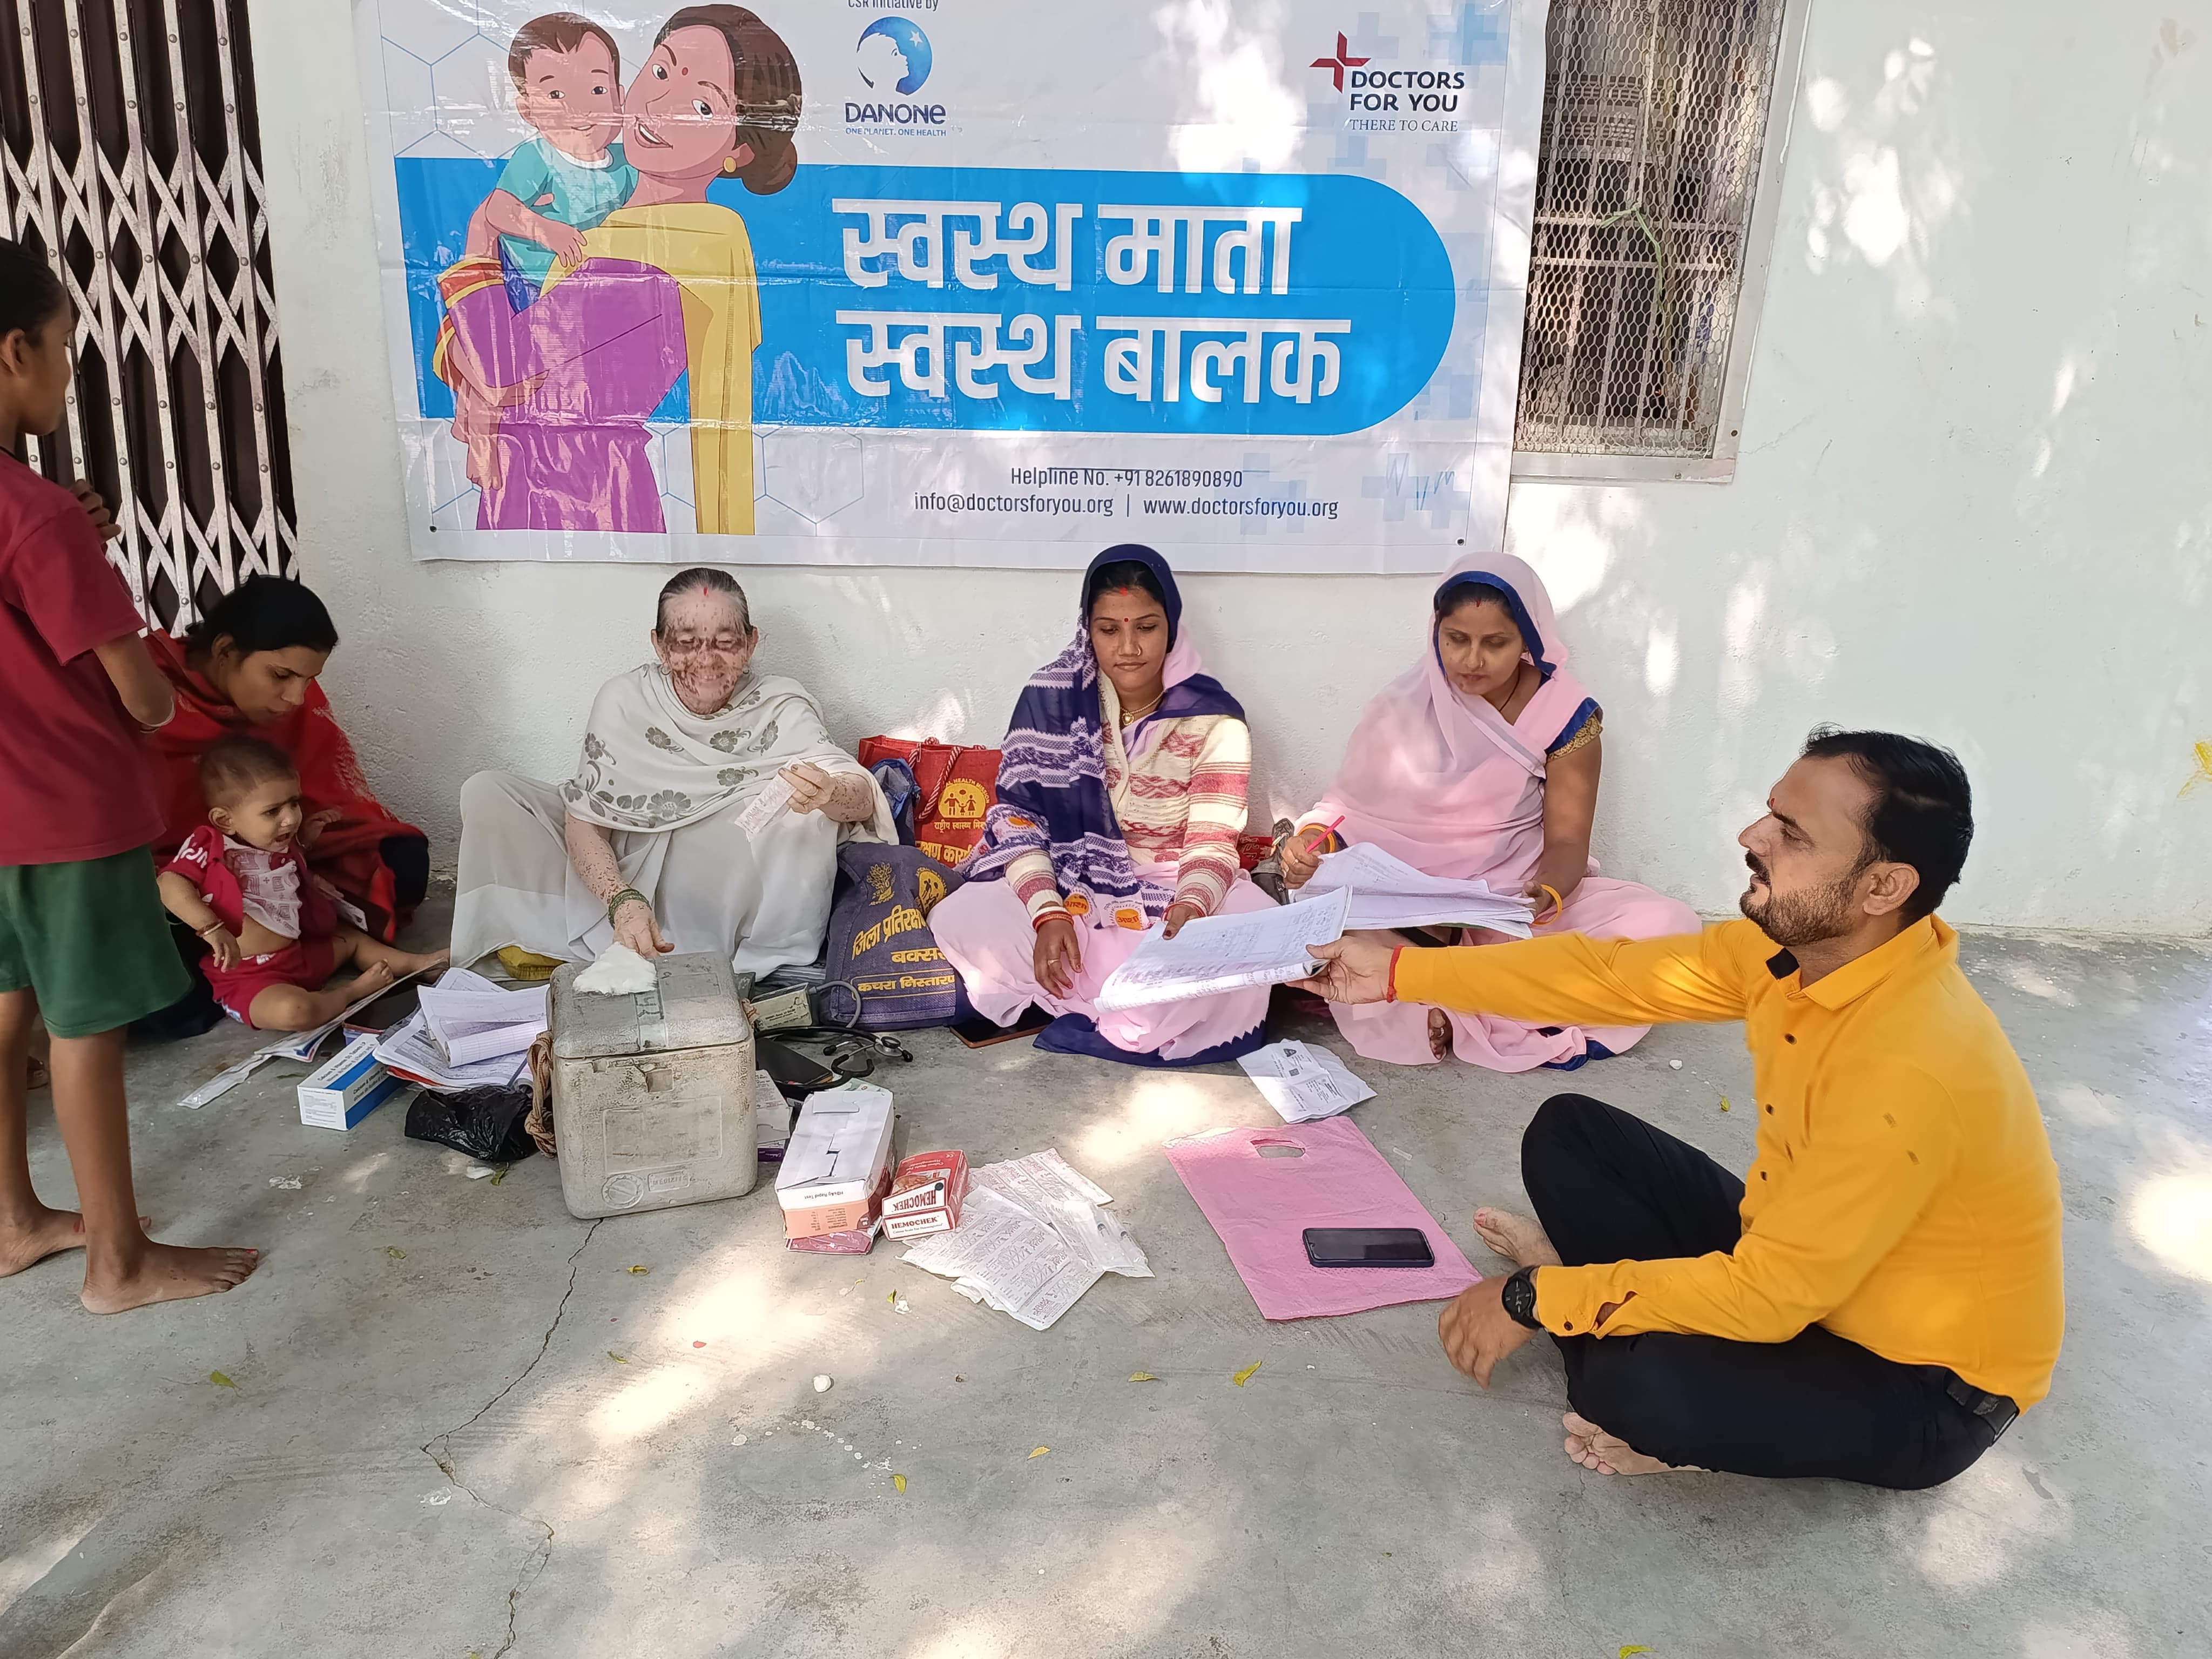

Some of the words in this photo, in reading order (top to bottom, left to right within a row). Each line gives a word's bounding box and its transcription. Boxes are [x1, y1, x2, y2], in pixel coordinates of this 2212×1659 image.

[1351, 70, 1465, 89] DOCTORS
[1350, 93, 1399, 111] FOR
[1408, 94, 1458, 112] YOU
[845, 127, 862, 135] ONE
[1348, 119, 1396, 131] THERE
[1399, 119, 1418, 131] TO
[1421, 120, 1458, 132] CARE
[832, 198, 1083, 292] स्वस्थ
[1098, 203, 1302, 295] माता
[835, 309, 1082, 400] स्वस्थ
[1096, 315, 1352, 404] बालक
[1011, 467, 1079, 488] Helpline
[1084, 468, 1109, 485] No.
[914, 491, 1114, 517] info@doctorsforyou.org
[1143, 497, 1339, 520] www.doctorsforyou.org
[953, 778, 976, 786] HEALTH
[933, 819, 951, 834] राष्ट्रीय
[952, 821, 972, 831] स्वास्थ्य
[1116, 915, 1139, 924] आशा
[852, 922, 881, 961] जिला
[882, 904, 929, 943] प्रतिरक्ष
[858, 980, 897, 992] कचरा
[893, 1190, 936, 1211] HEMOCHEK
[892, 1216, 938, 1229] HEMOCHEK
